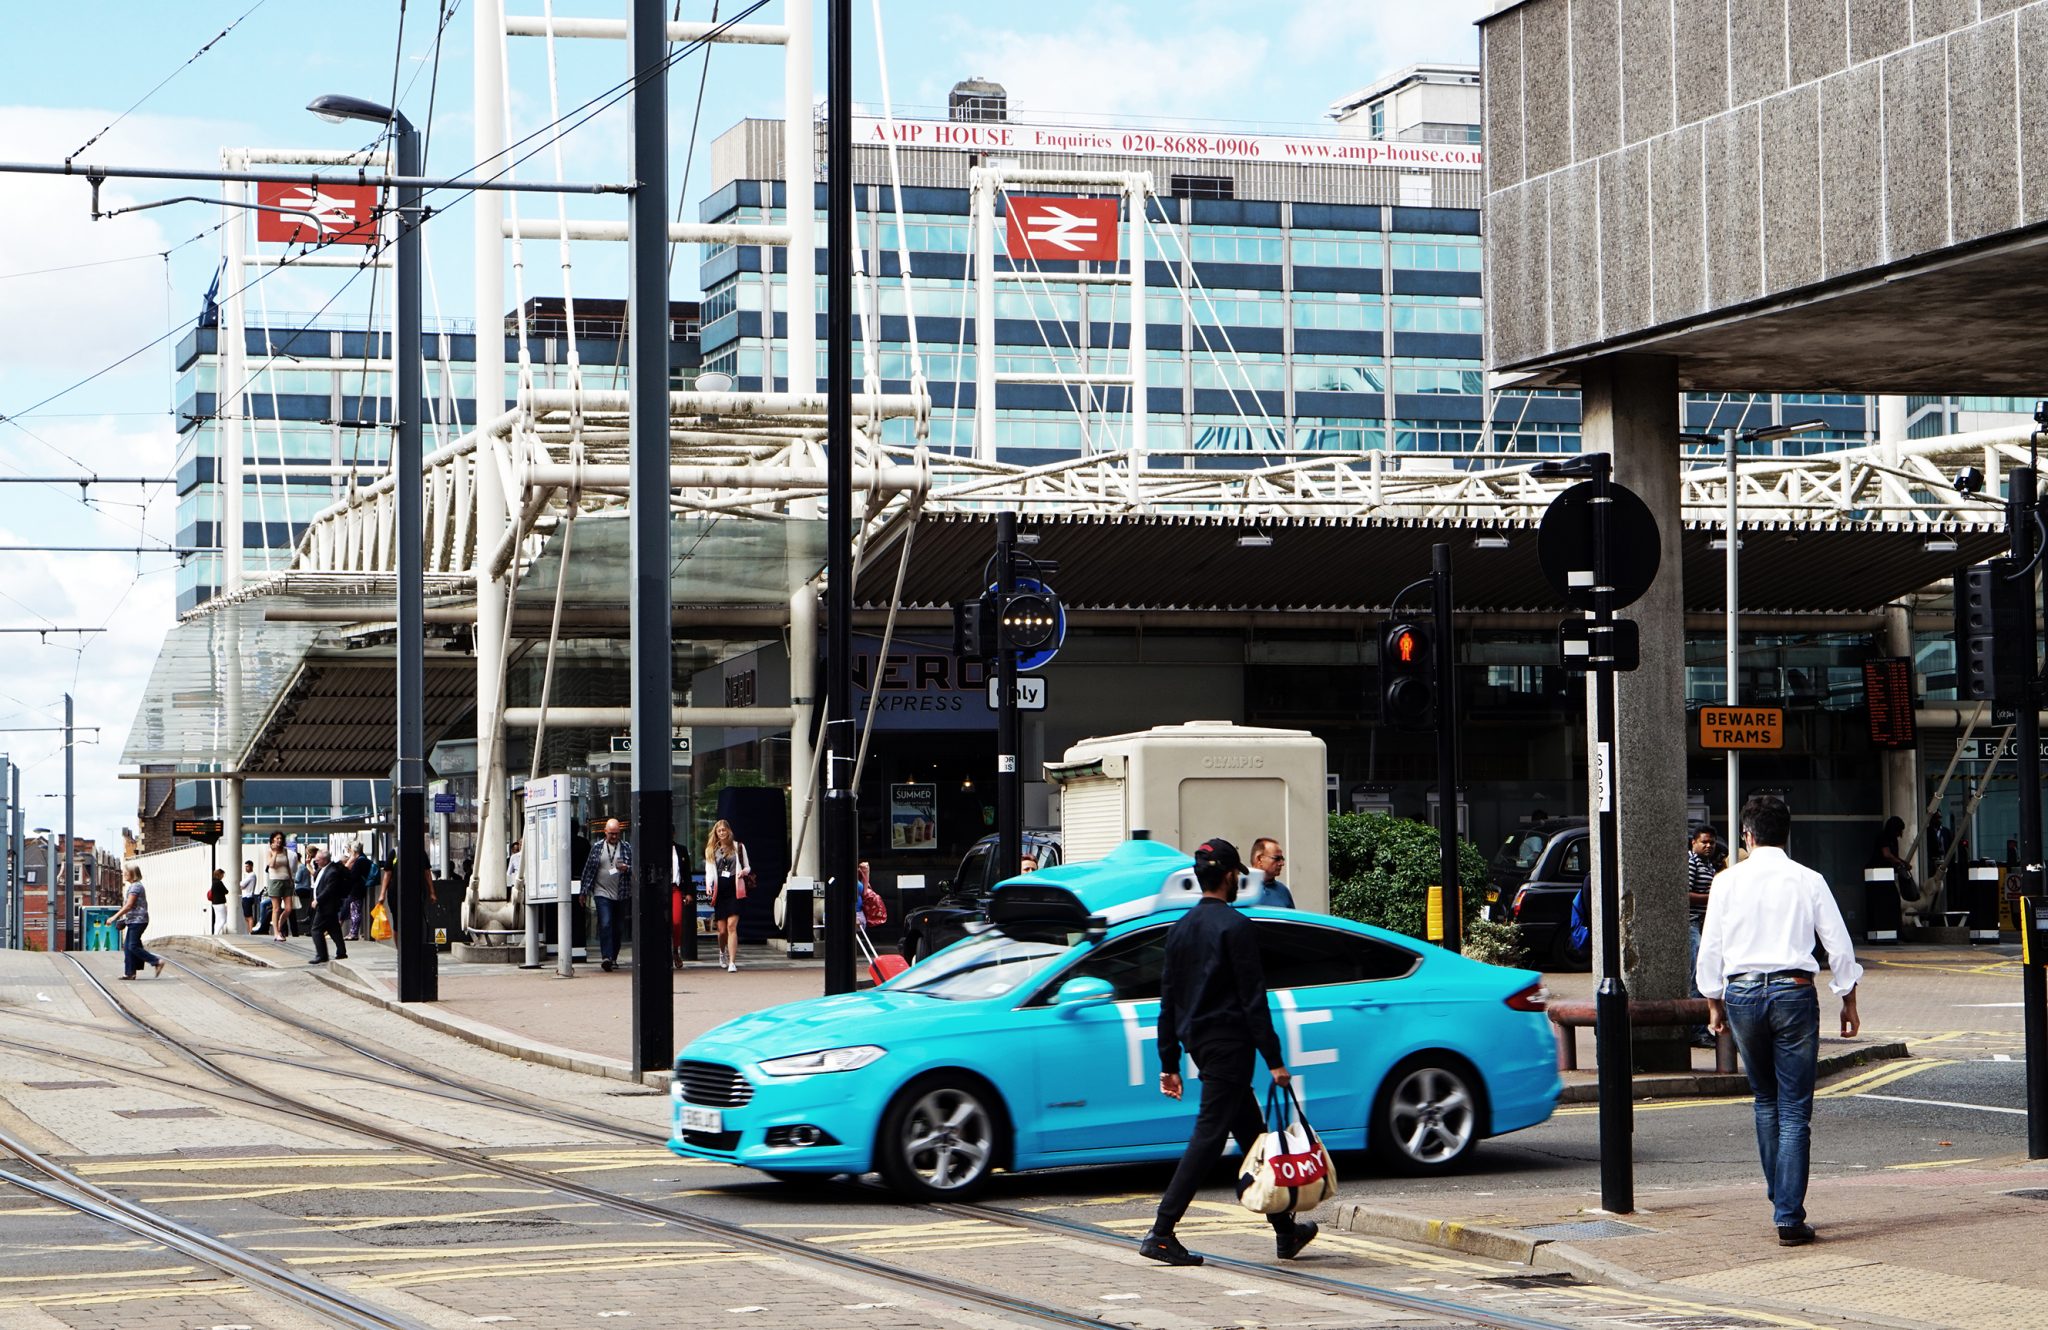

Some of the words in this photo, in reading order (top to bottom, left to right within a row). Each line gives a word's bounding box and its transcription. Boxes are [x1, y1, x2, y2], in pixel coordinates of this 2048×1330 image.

[871, 124, 922, 142] AMP
[935, 126, 1014, 146] HOUSE
[1035, 131, 1111, 149] Enquiries
[1122, 134, 1260, 157] 020-8688-0906
[860, 696, 962, 711] EXPRESS
[1706, 713, 1777, 726] BEWARE
[1713, 730, 1771, 743] TRAMS
[1201, 755, 1264, 769] OLYMPIC
[896, 790, 932, 799] SUMMER
